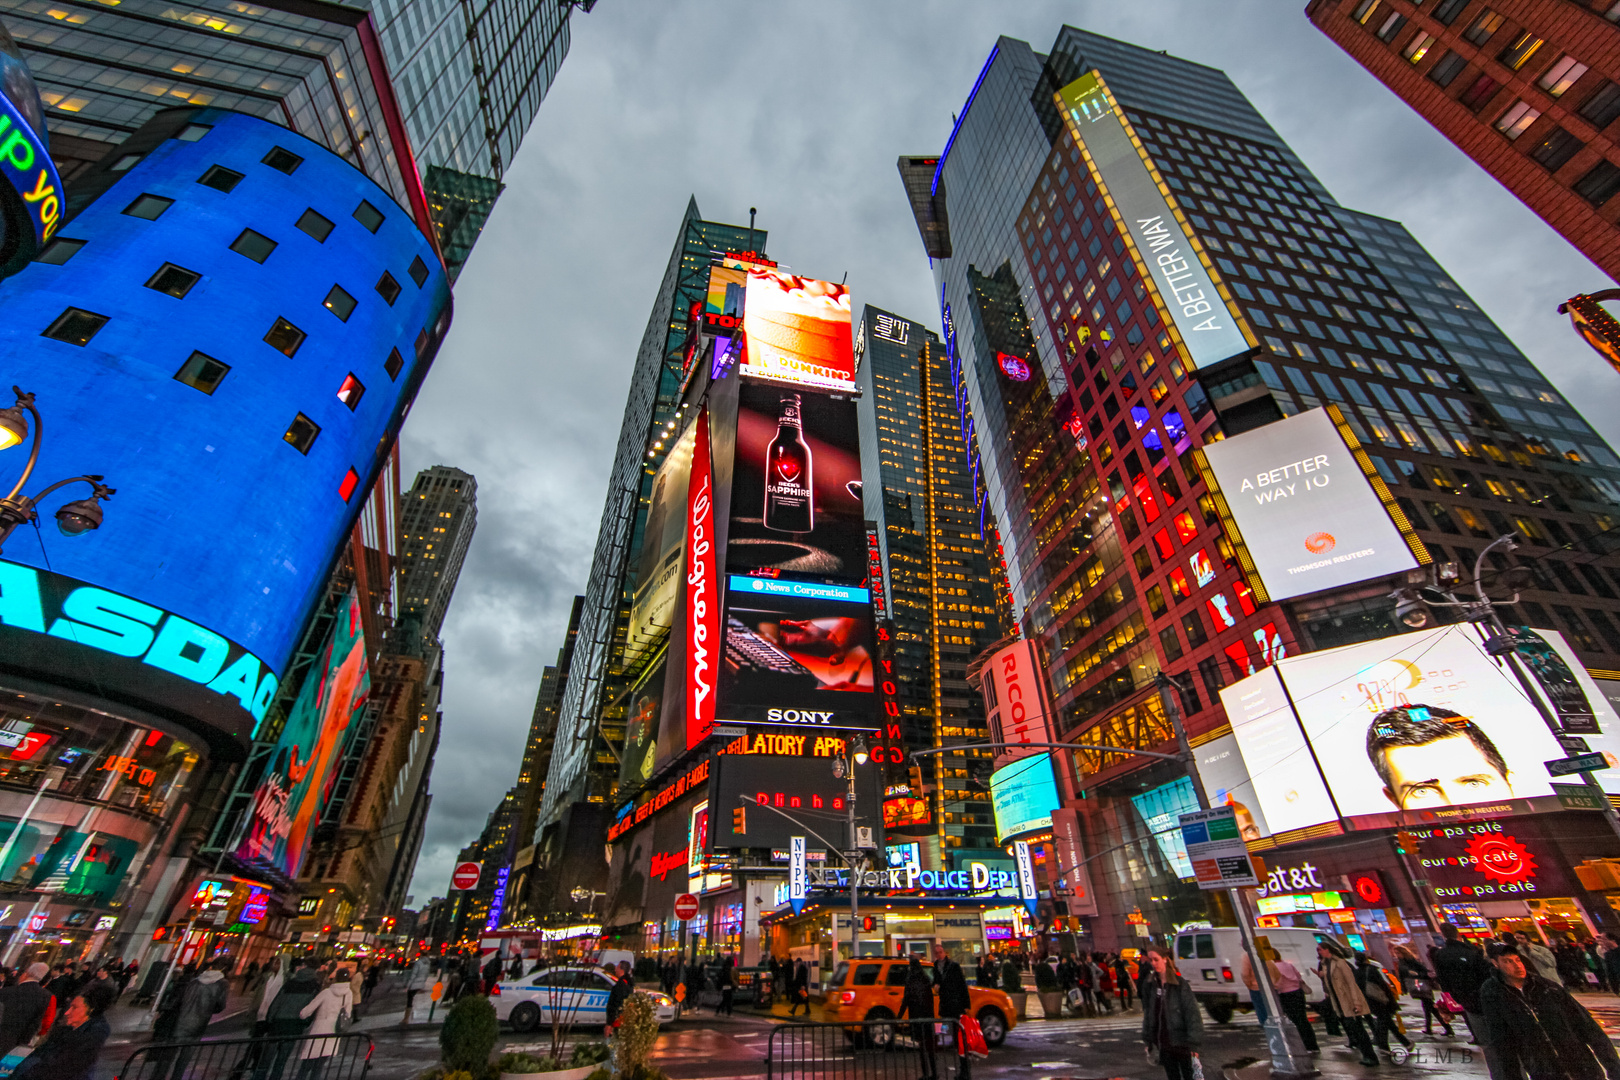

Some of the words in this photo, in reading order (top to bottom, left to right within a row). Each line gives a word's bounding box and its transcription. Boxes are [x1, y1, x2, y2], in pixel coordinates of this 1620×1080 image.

[23, 169, 59, 242] you
[1137, 215, 1175, 253] WAY
[725, 252, 777, 268] TOSHIBA
[1157, 248, 1212, 318] BETTER
[1192, 315, 1222, 331] A
[1240, 478, 1254, 493] A
[1256, 454, 1330, 487] BETTER
[767, 484, 811, 497] SAPPHIRE
[1255, 483, 1296, 505] WAY
[1287, 558, 1333, 575] THOMSON
[1333, 548, 1375, 564] REUTERS
[688, 474, 711, 721] Walgreens
[765, 581, 790, 593] News
[793, 584, 849, 598] Corporation
[1001, 652, 1031, 744] RICOH
[767, 708, 834, 724] SONY
[1555, 762, 1570, 772] ONE
[1580, 757, 1597, 767] WAY
[1435, 807, 1475, 818] THOMSON
[1476, 804, 1513, 815] REUTERS
[794, 839, 803, 896] NYPD
[906, 862, 969, 889] POLICE
[970, 862, 1017, 889] DEPT
[1019, 843, 1033, 898] NYPD
[1266, 861, 1323, 893] at&t
[1434, 884, 1495, 897] europa
[943, 918, 972, 927] POLICE
[586, 995, 608, 1006] NYP
